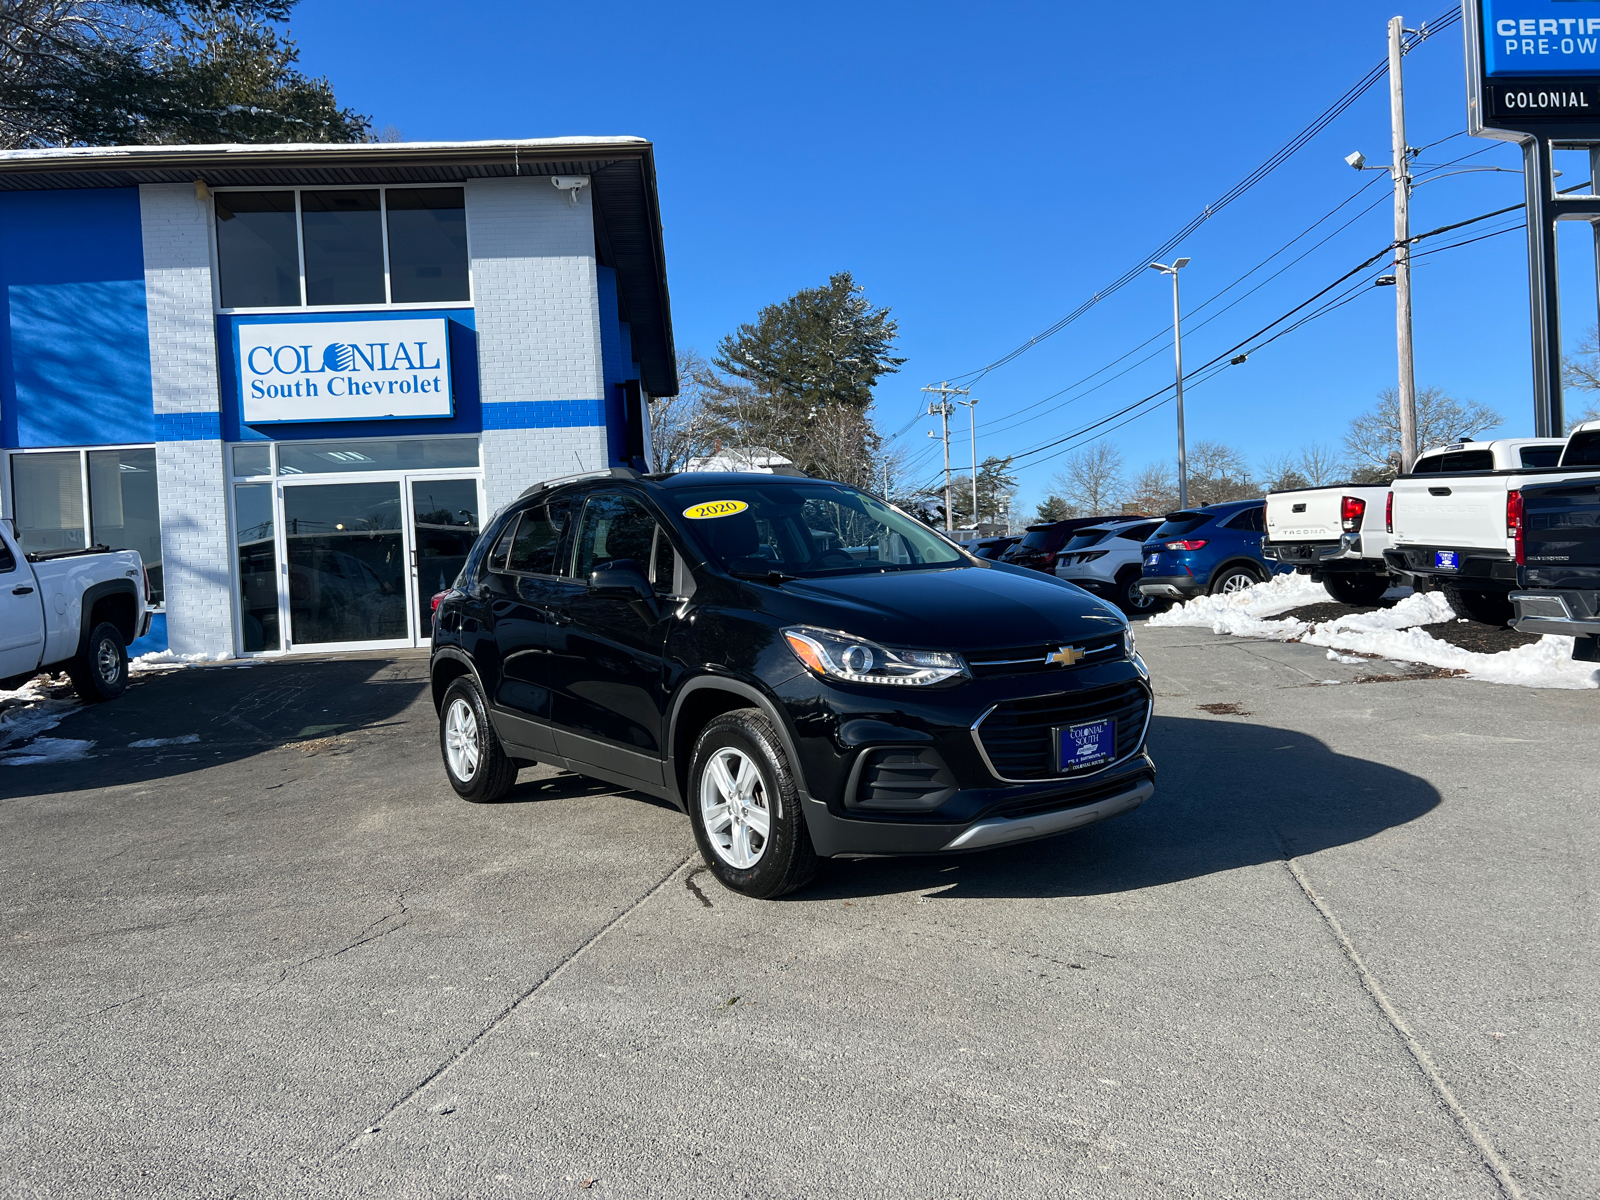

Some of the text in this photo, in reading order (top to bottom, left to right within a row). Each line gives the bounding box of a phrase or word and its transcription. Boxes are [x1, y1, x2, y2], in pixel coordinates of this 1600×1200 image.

[1497, 18, 1600, 36] CERTIF
[1505, 38, 1598, 55] PRE-OW
[1504, 91, 1589, 109] COLONIAL
[247, 342, 441, 376] COLONIAL
[251, 374, 442, 400] South Chevrolet
[695, 501, 738, 517] 2020
[1399, 504, 1488, 514] CHEVROLET
[1070, 724, 1104, 740] COLONIAL
[1075, 734, 1099, 747] SOUTH
